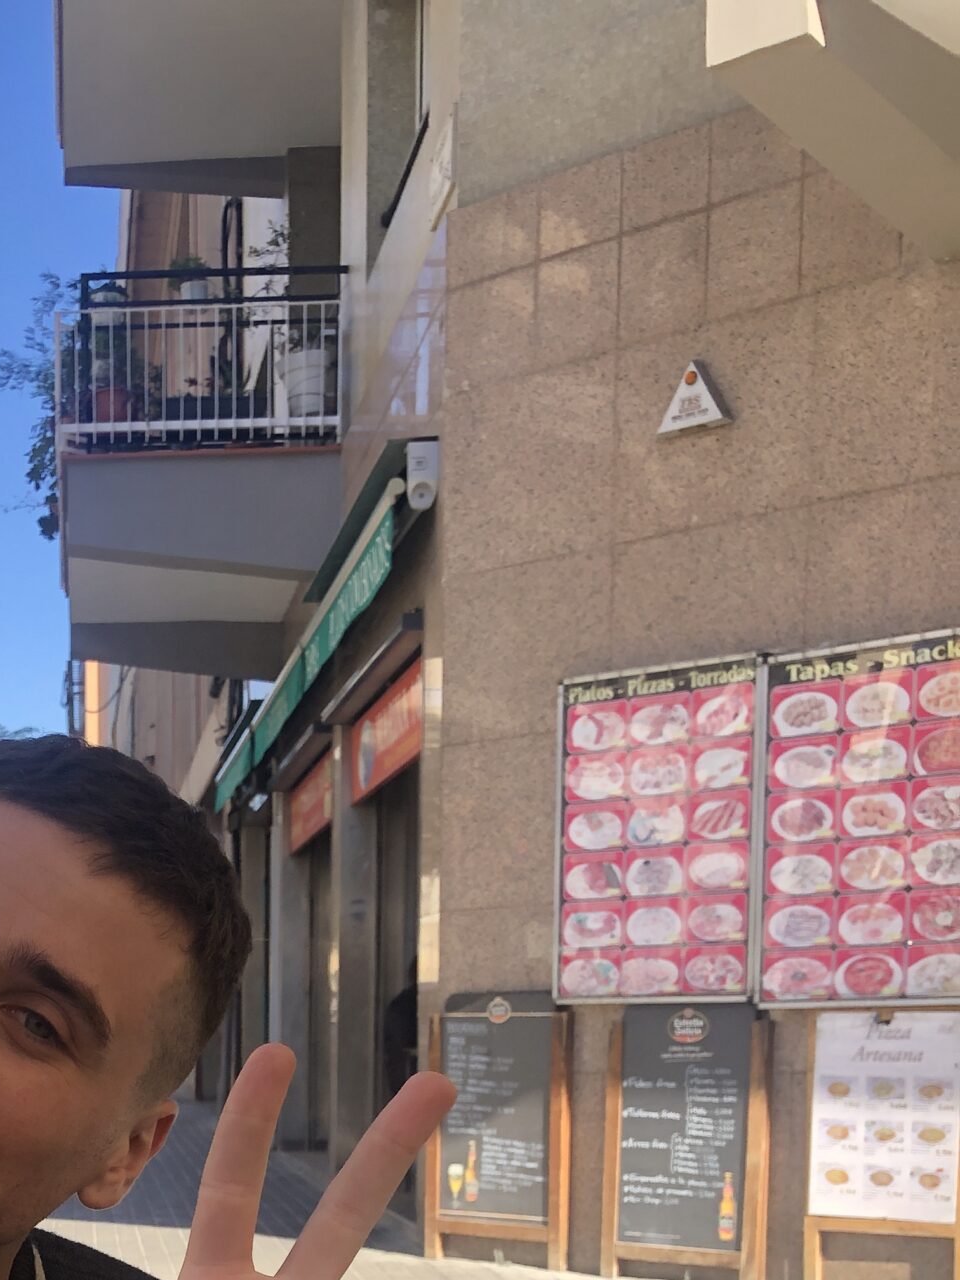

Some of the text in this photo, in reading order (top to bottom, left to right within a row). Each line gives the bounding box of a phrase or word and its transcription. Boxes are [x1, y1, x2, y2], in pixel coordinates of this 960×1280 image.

[568, 686, 614, 704] Platos
[627, 675, 675, 696] Pizzas
[689, 664, 756, 689] Torradas
[785, 658, 859, 683] Tapas
